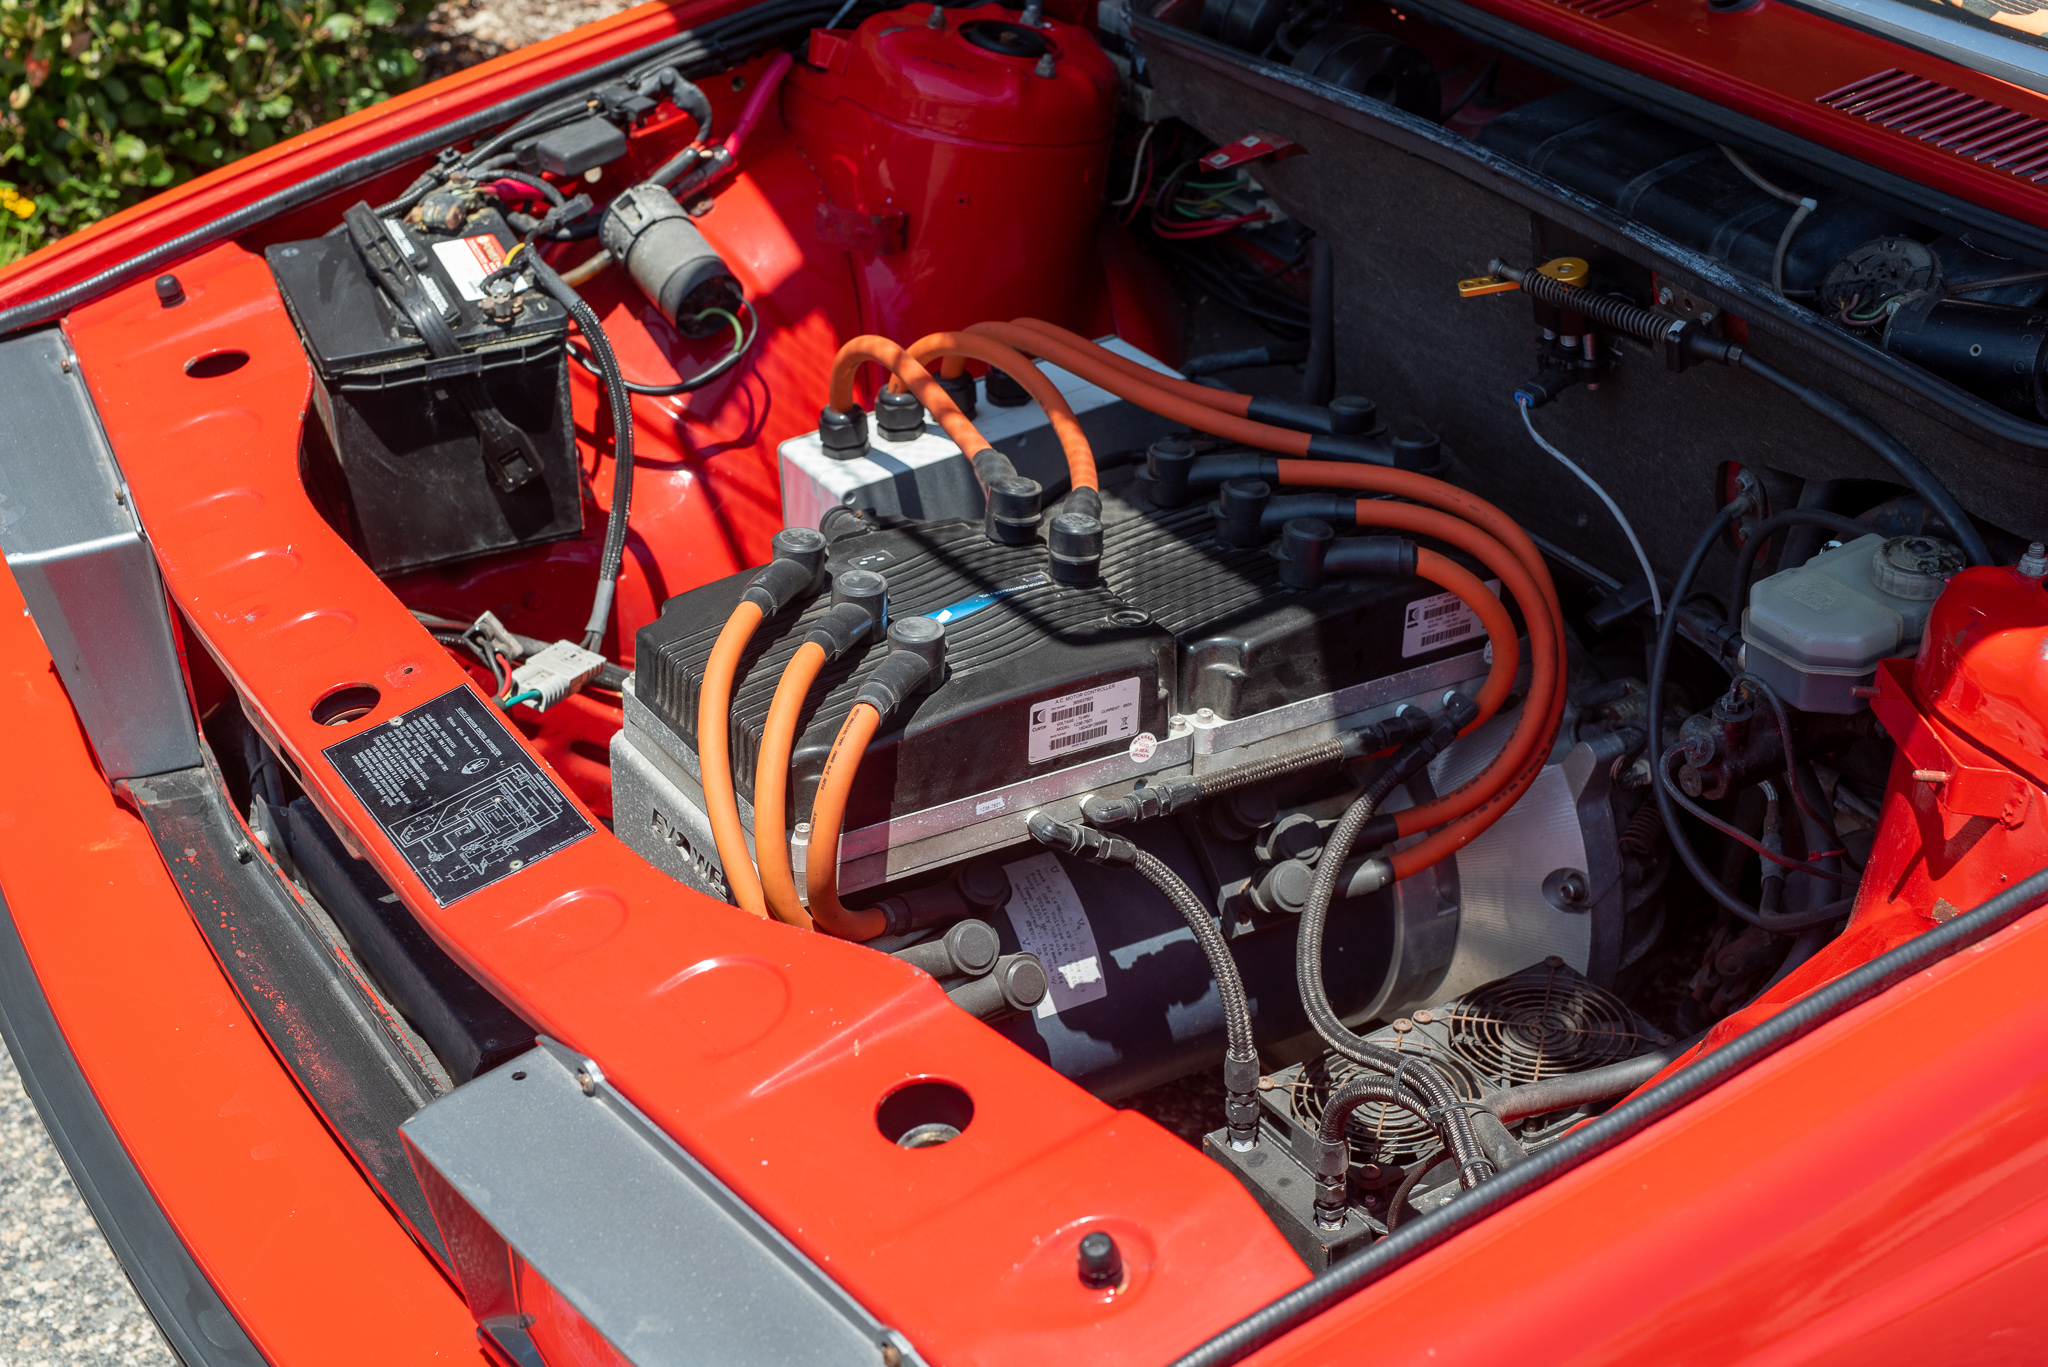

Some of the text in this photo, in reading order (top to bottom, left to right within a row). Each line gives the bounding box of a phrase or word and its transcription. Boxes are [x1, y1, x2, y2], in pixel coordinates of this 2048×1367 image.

[1066, 692, 1084, 701] MOTOR
[1084, 684, 1115, 697] CONTROLLER
[1133, 735, 1156, 746] WARRANTY
[1035, 868, 1046, 882] Peak
[1013, 881, 1038, 928] Manufactured
[1046, 961, 1054, 972] USA
[1035, 896, 1052, 924] Utility
[1050, 927, 1062, 957] Vehicle
[1051, 911, 1064, 939] Voltage
[1021, 937, 1031, 946] V
